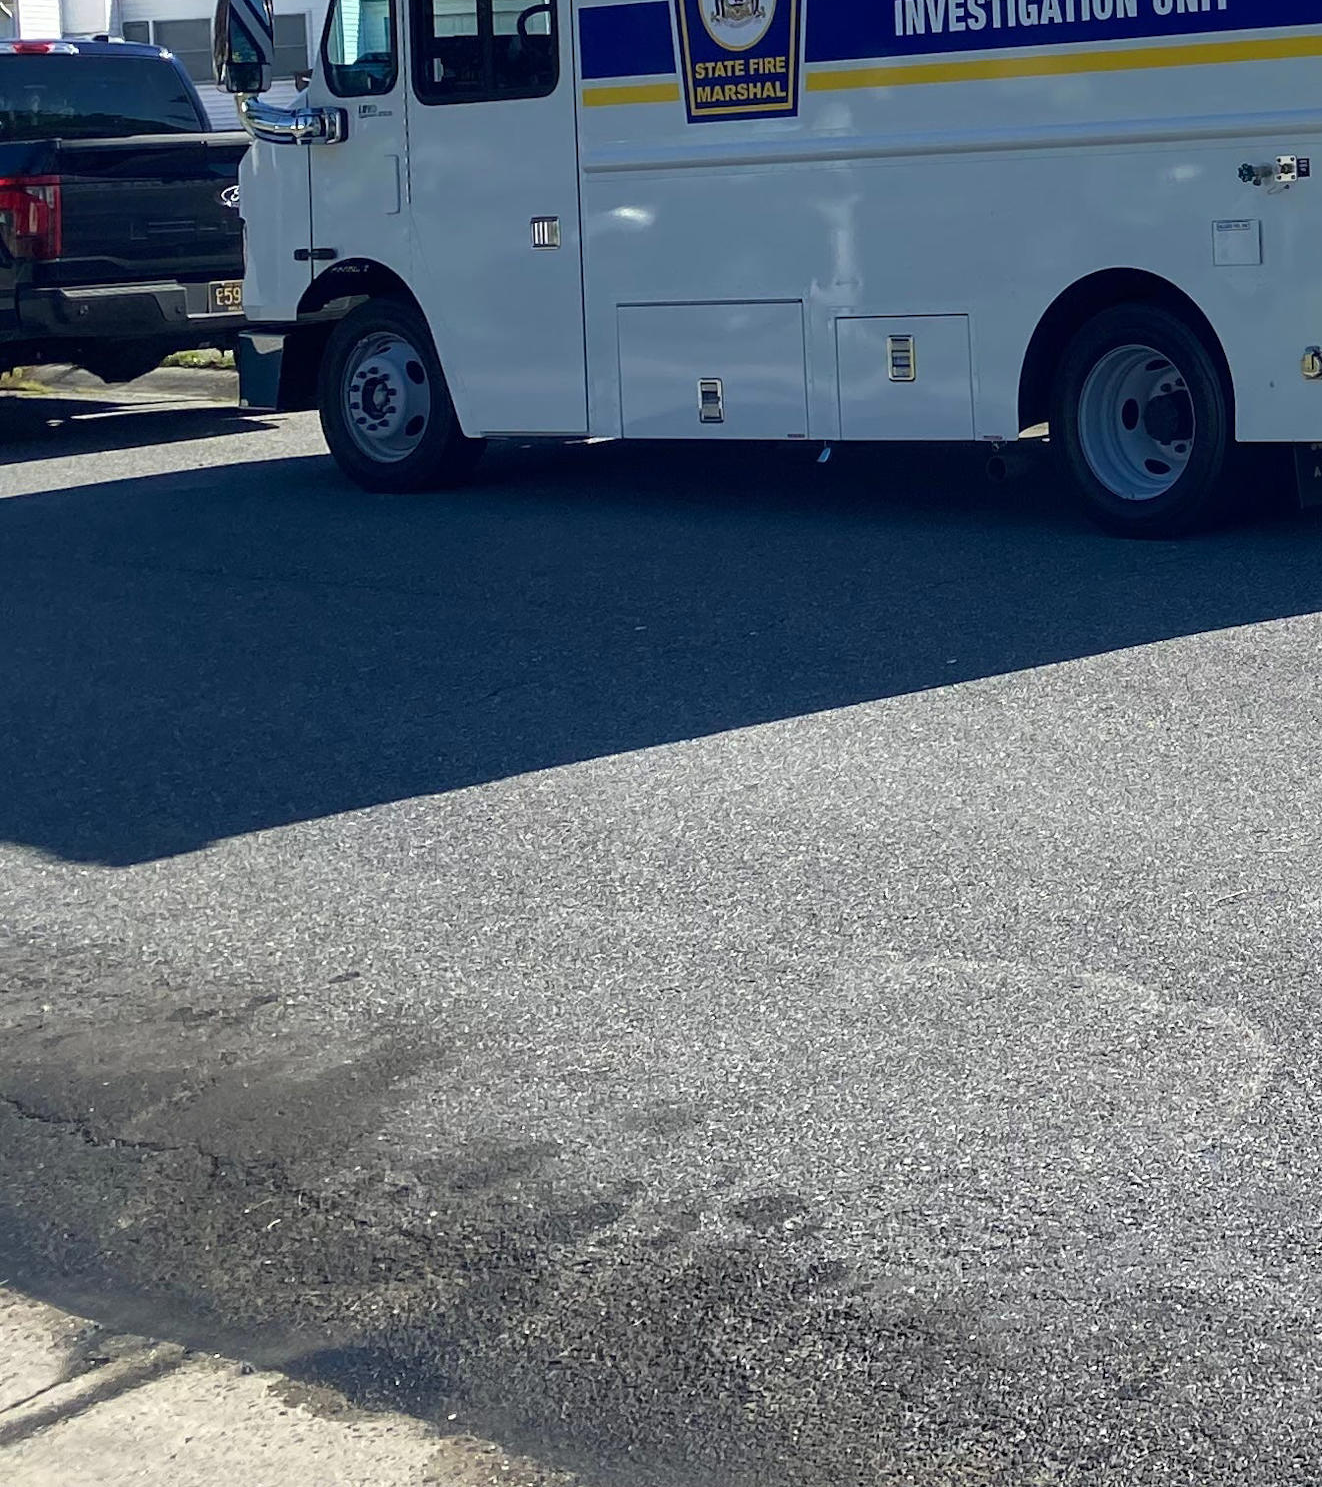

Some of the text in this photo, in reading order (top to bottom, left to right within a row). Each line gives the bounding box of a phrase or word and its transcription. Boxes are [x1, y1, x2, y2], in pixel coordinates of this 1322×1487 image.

[695, 57, 786, 79] STATE FIRE
[696, 81, 786, 103] MARSHAL
[1314, 465, 1322, 478] A
